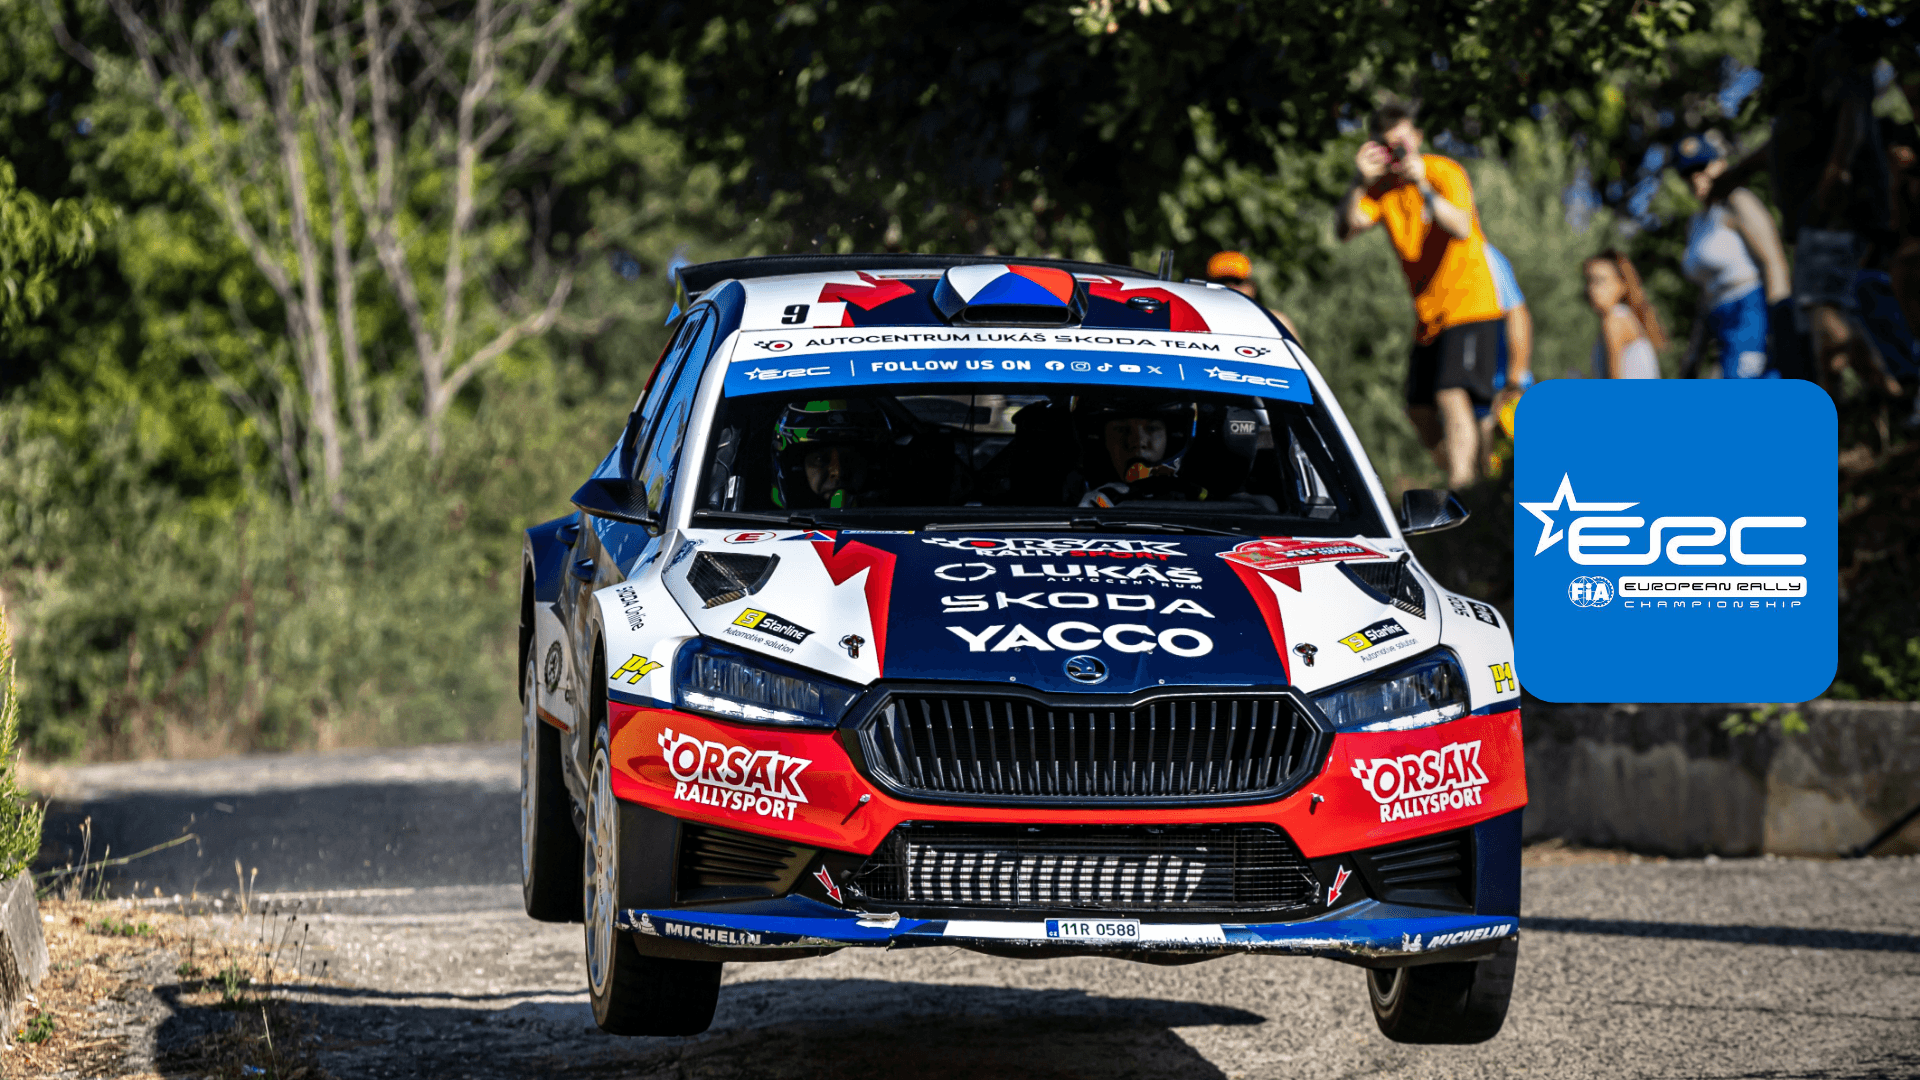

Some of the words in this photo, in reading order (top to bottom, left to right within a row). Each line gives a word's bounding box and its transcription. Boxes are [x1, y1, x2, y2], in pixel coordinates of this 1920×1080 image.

[781, 304, 810, 325] 9
[805, 333, 970, 347] AUTOCENTRUM
[977, 332, 1046, 342] LUKÁŠ
[1161, 339, 1220, 352] TEAM
[758, 366, 831, 381] ERC
[871, 360, 958, 372] FOLLOW
[965, 360, 995, 370] US
[1001, 360, 1032, 370] ON
[1218, 371, 1290, 389] ERC
[1230, 423, 1255, 434] OMP
[957, 538, 1188, 556] ORSAK
[1010, 563, 1203, 584] LUKÁŠ
[1047, 577, 1203, 590] AUTOCENTRUM
[759, 618, 807, 640] Starline
[945, 621, 1214, 657] YACCO
[1364, 624, 1403, 641] Starline
[723, 627, 764, 644] Automotive
[764, 639, 794, 654] solution
[1360, 645, 1397, 663] Automotive
[1395, 638, 1418, 650] solution
[669, 733, 812, 803] ORSAK
[1370, 740, 1489, 803] ORSAK
[673, 781, 798, 821] RALLYSPORT
[1379, 786, 1482, 823] RALLYSPORT
[665, 922, 761, 945] MICHELIN
[1061, 923, 1090, 936] 11R
[1096, 923, 1136, 936] 0588
[1427, 923, 1512, 948] MICHELIN
